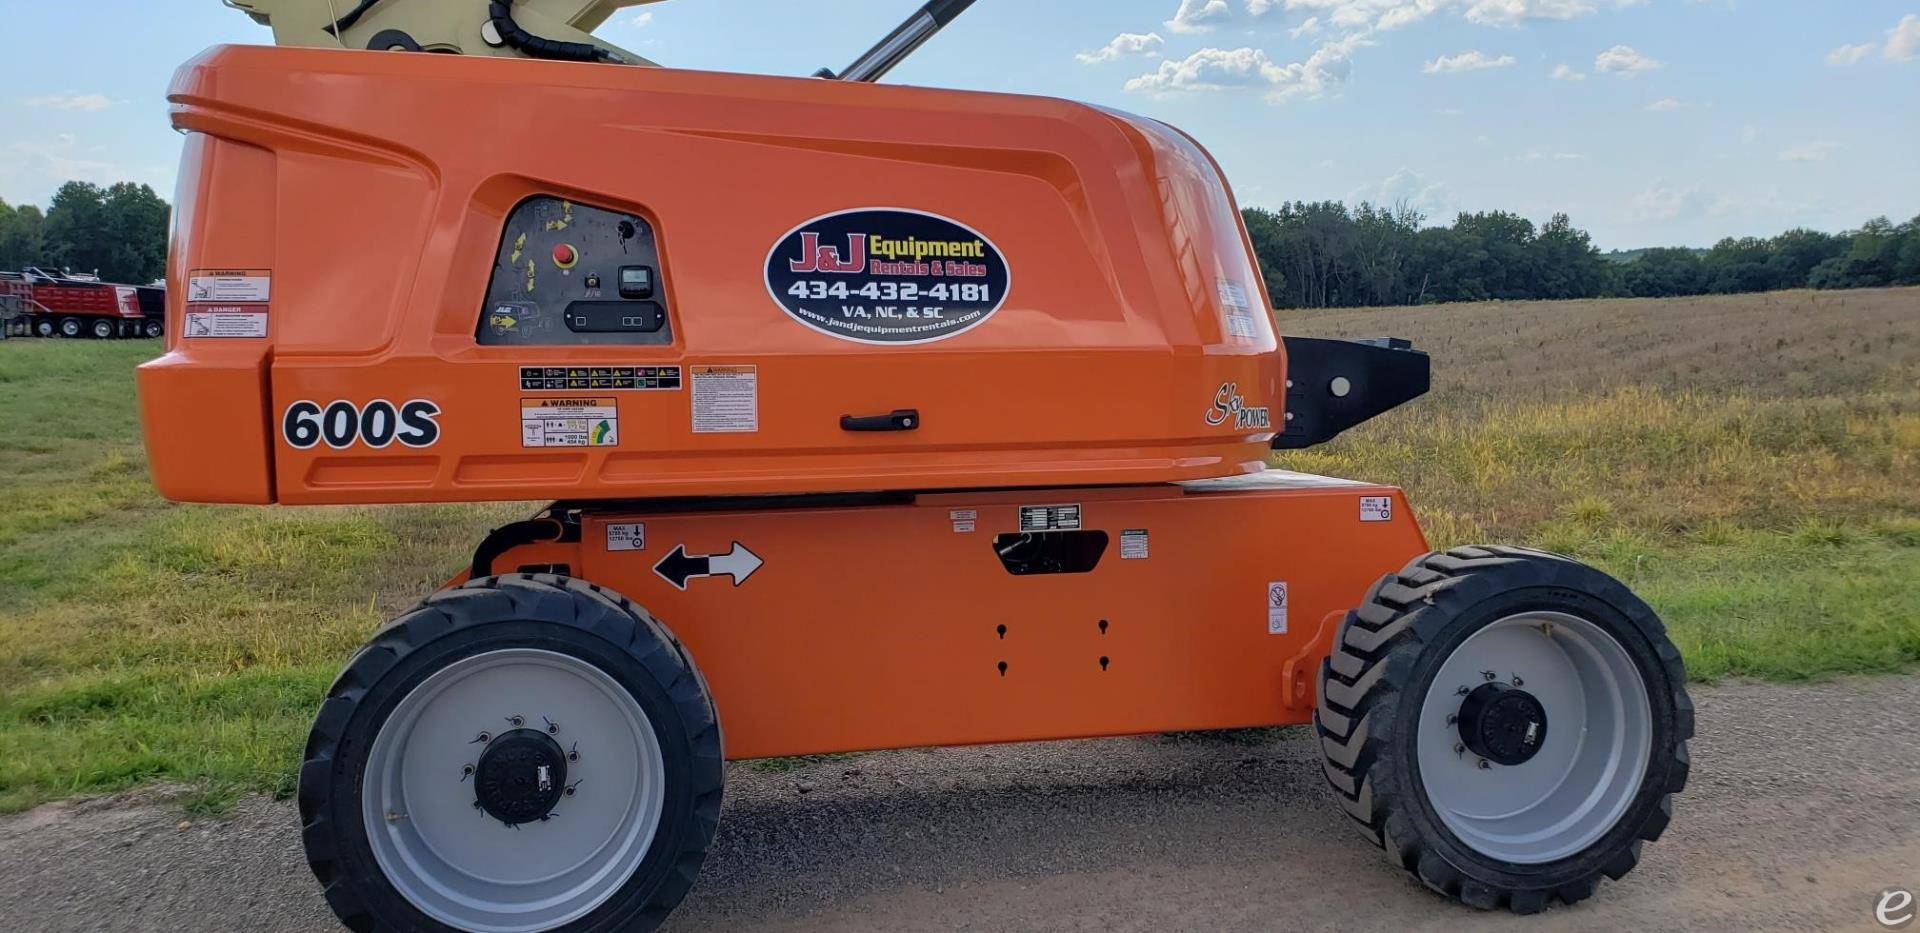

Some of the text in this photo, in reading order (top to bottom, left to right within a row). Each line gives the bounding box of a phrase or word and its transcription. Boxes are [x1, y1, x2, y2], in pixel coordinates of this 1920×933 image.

[789, 231, 866, 273] J&J
[869, 235, 985, 260] Equipment
[870, 259, 986, 276] Rentals & Sales
[787, 280, 990, 302] 434-432-4181
[798, 307, 981, 335] www.jandjequipmentrentals.com
[841, 305, 944, 320] VA, NC, & SC
[550, 399, 597, 407] WARNING
[283, 399, 442, 449] 600S
